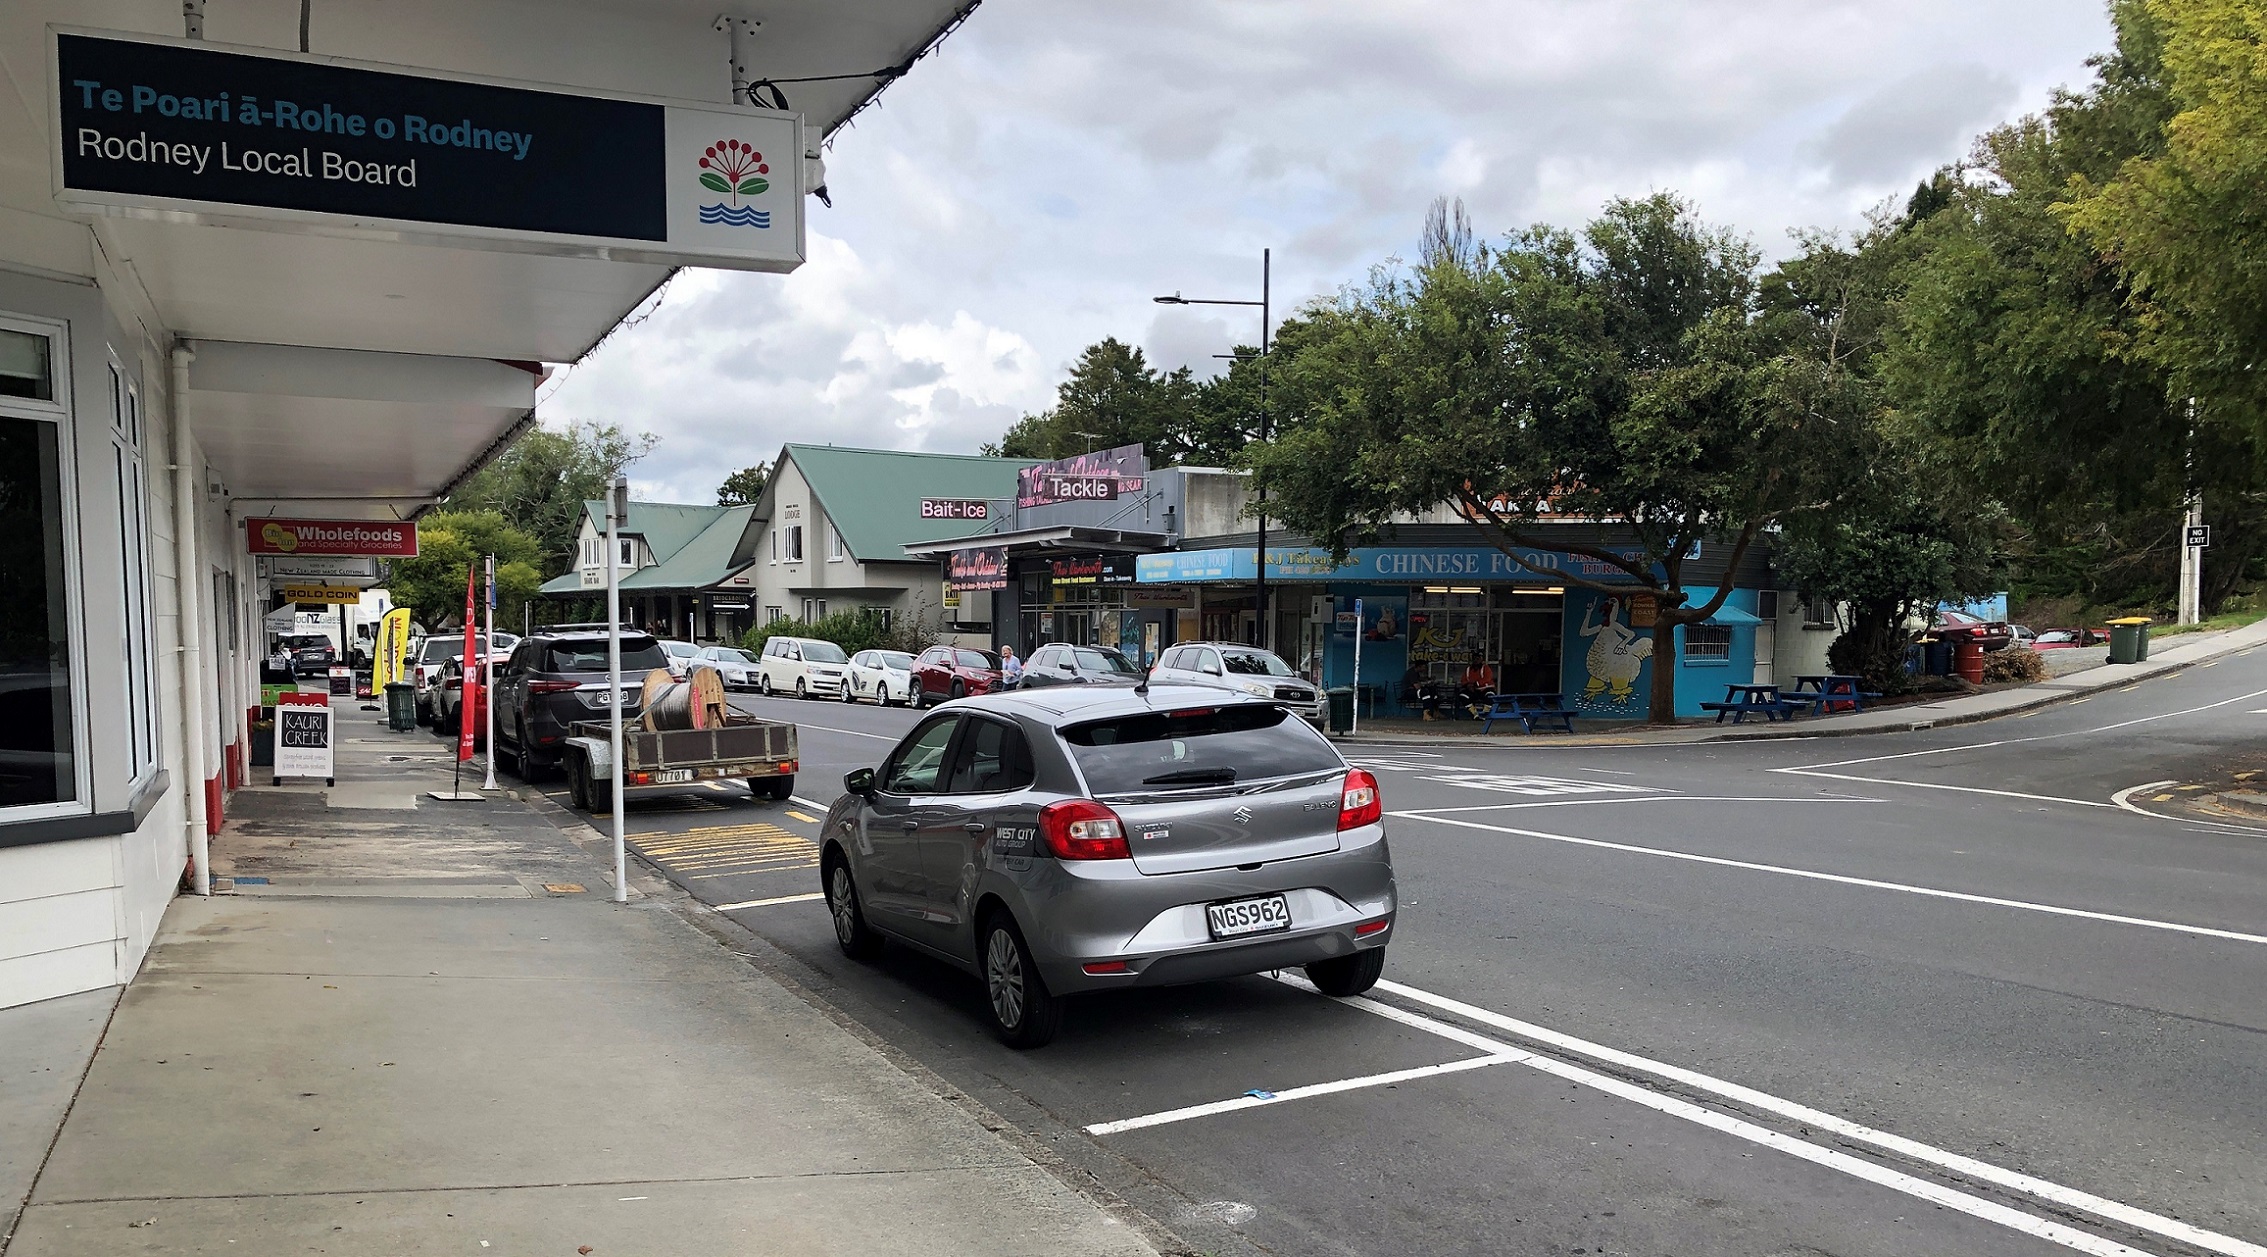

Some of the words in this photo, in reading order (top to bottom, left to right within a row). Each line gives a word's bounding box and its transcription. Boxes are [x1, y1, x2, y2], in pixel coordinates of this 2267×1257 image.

[73, 79, 123, 112] Te
[132, 84, 230, 122] Poari
[239, 95, 366, 137] ā-Rohe
[374, 117, 396, 140] o
[404, 114, 533, 161] Rodney
[78, 127, 211, 175] Rodney
[221, 141, 313, 178] Local
[322, 151, 417, 188] Board
[1050, 478, 1108, 498] Tackle
[922, 500, 986, 518] Bait-Ice
[297, 526, 403, 542] Wholefoods
[2189, 536, 2206, 544] EXIT
[318, 540, 358, 550] Specialty
[360, 541, 402, 549] Groceries
[1208, 553, 1228, 568] FOOD
[1375, 553, 1479, 574] CHINESE
[1490, 553, 1558, 574] FOOD
[287, 590, 323, 598] GOLD
[326, 590, 357, 599] COIN
[285, 714, 323, 730] KAURI
[285, 730, 328, 746] CREEK
[996, 827, 1017, 839] WEST
[1017, 828, 1036, 841] CITY
[1211, 899, 1287, 930] NGS962
